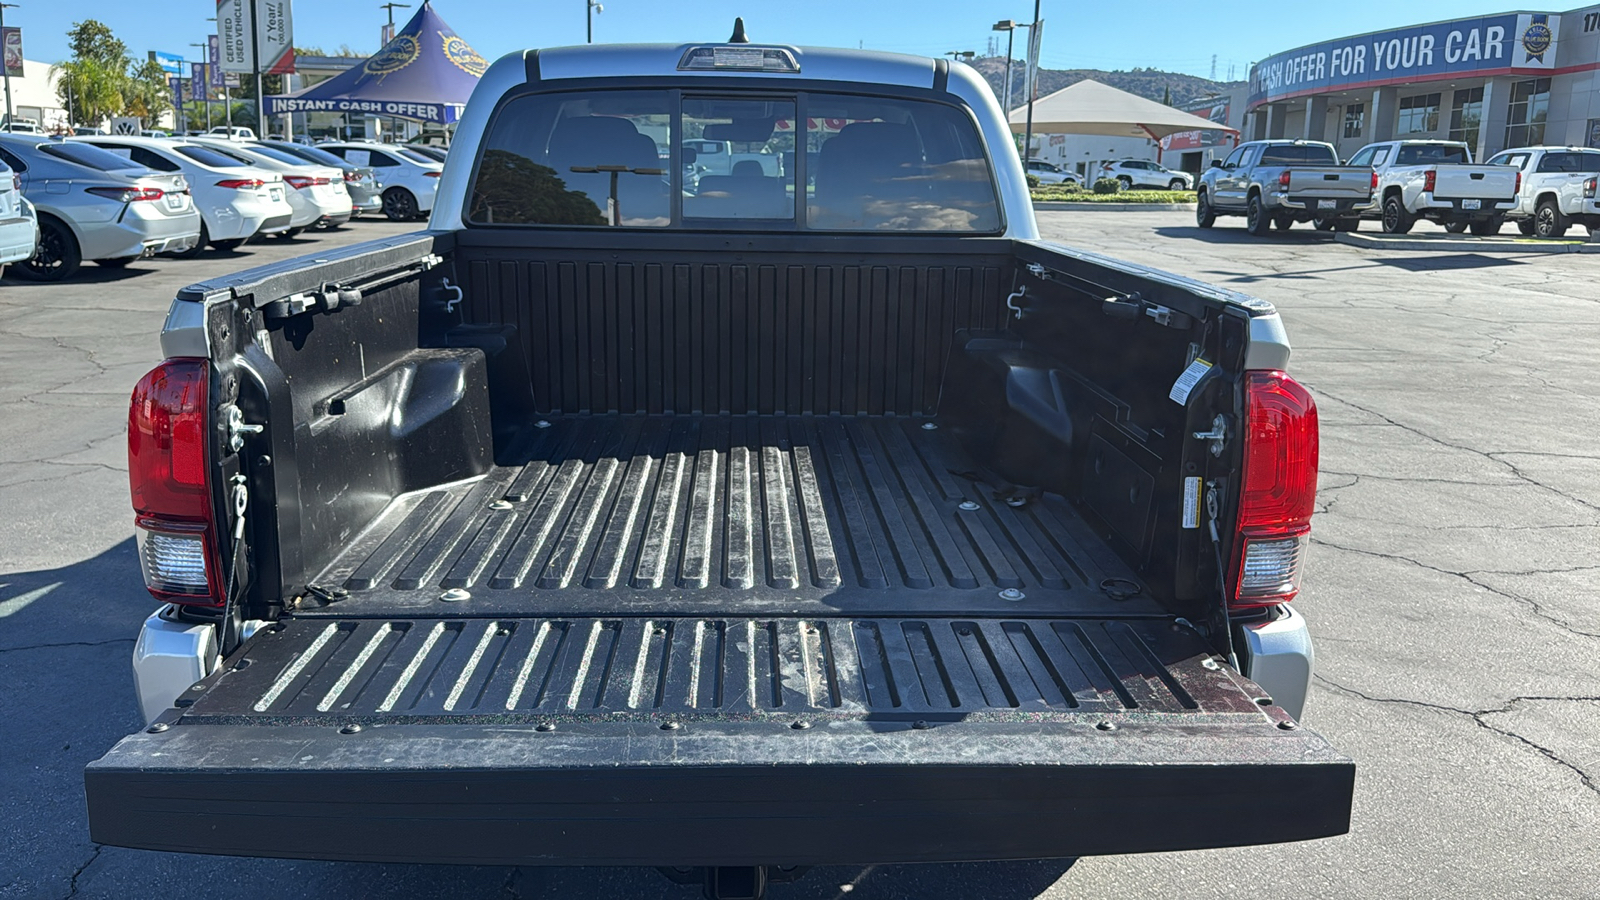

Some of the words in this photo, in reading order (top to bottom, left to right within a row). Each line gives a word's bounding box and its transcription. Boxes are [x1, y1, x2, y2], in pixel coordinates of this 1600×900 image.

[234, 0, 243, 37] VEHICLE
[265, 3, 276, 33] Year/
[277, 19, 285, 45] 100,000
[225, 18, 234, 63] CERTIFIED
[236, 39, 244, 63] USED
[1261, 62, 1283, 92] CASH
[1285, 52, 1326, 86] OFFER
[1330, 45, 1366, 78] FOR
[1373, 34, 1435, 71] YOUR
[1444, 25, 1505, 64] CAR
[272, 98, 336, 113] INSTANT
[339, 101, 381, 112] CASH
[386, 102, 438, 120] OFFER
